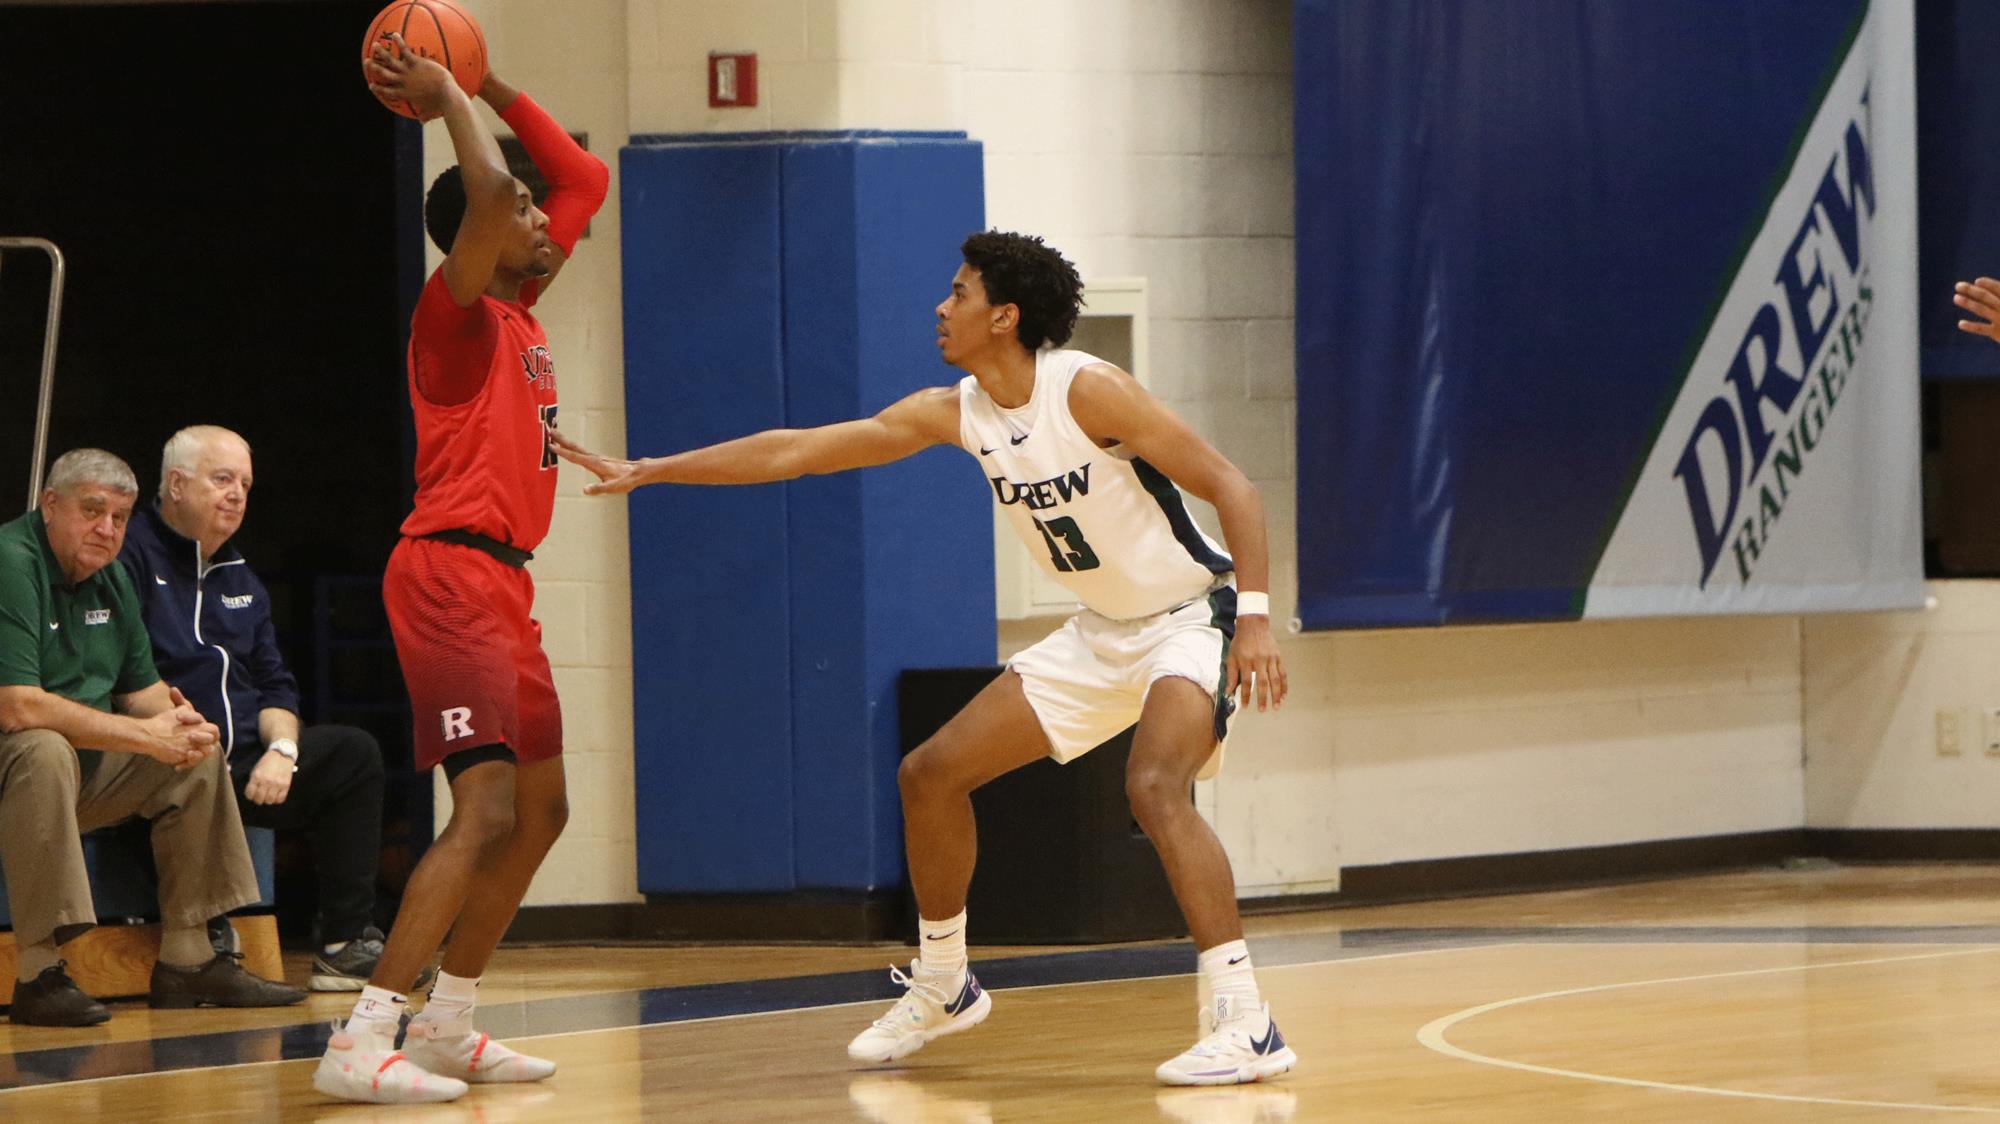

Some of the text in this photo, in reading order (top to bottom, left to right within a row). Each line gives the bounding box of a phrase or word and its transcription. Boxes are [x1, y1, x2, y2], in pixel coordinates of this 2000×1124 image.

[1673, 80, 1876, 592] DREW
[1731, 262, 1873, 590] RANGERS
[991, 462, 1091, 510] DREW
[1031, 516, 1100, 572] 13
[441, 706, 475, 742] R
